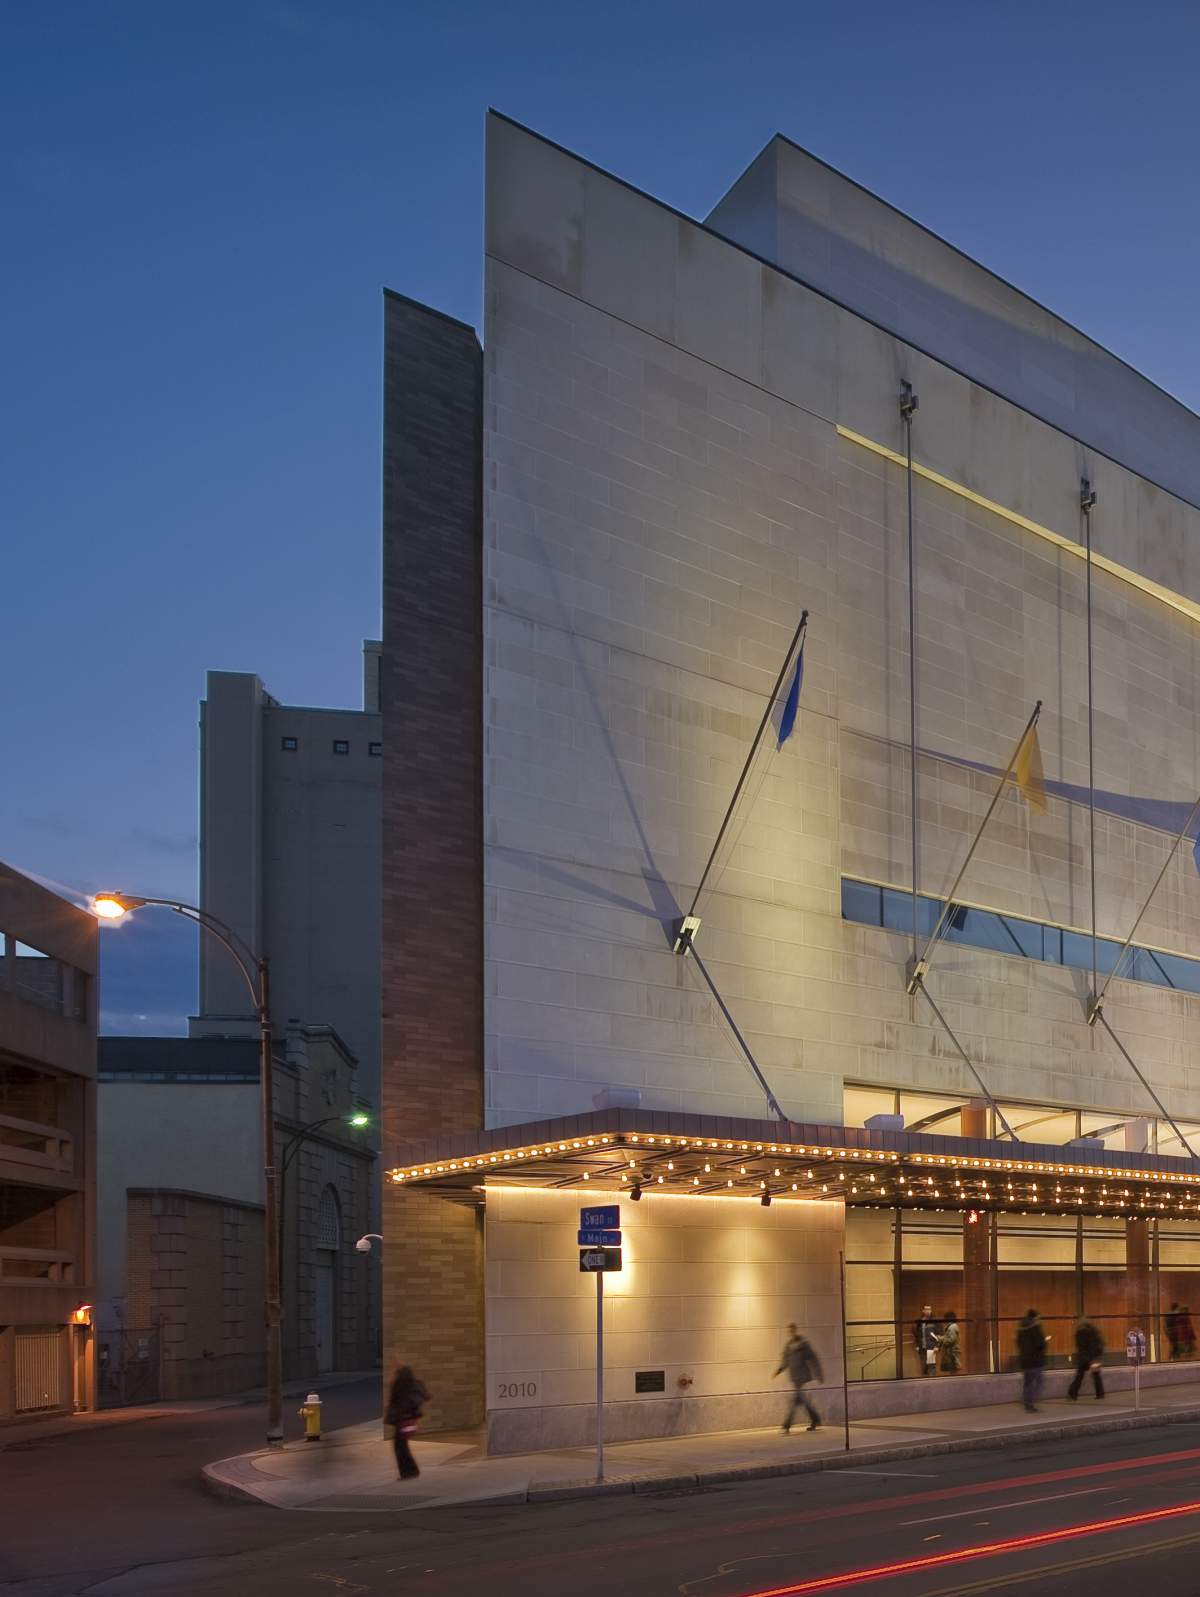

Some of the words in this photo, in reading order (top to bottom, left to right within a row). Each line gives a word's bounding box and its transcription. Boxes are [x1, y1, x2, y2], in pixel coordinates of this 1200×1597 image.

[585, 1212, 605, 1226] Swan
[587, 1231, 608, 1244] Main
[587, 1255, 601, 1265] ONE
[498, 1382, 537, 1399] 2010
